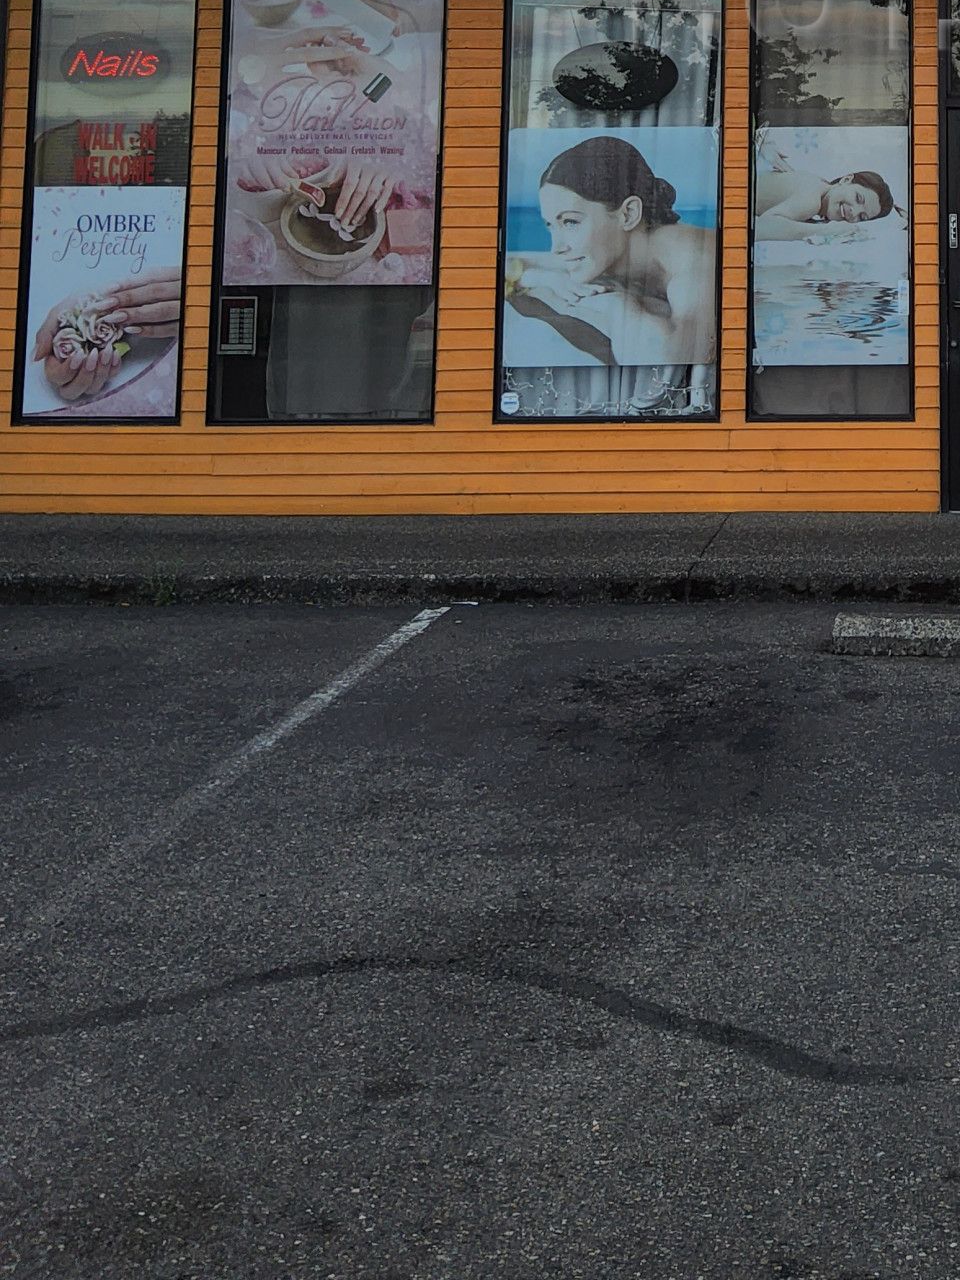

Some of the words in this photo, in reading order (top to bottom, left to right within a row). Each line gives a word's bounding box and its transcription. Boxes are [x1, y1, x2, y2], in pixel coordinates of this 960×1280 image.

[67, 48, 161, 78] Nails
[258, 74, 357, 133] Nail
[353, 116, 408, 131] SALON
[257, 146, 287, 155] Manicure
[291, 146, 319, 155] Pedicure
[351, 146, 376, 156] Eyelash
[380, 146, 405, 156] Waxing
[74, 155, 156, 184] WELCOME
[76, 214, 156, 233] OMBRE
[53, 228, 148, 275] Perfectly
